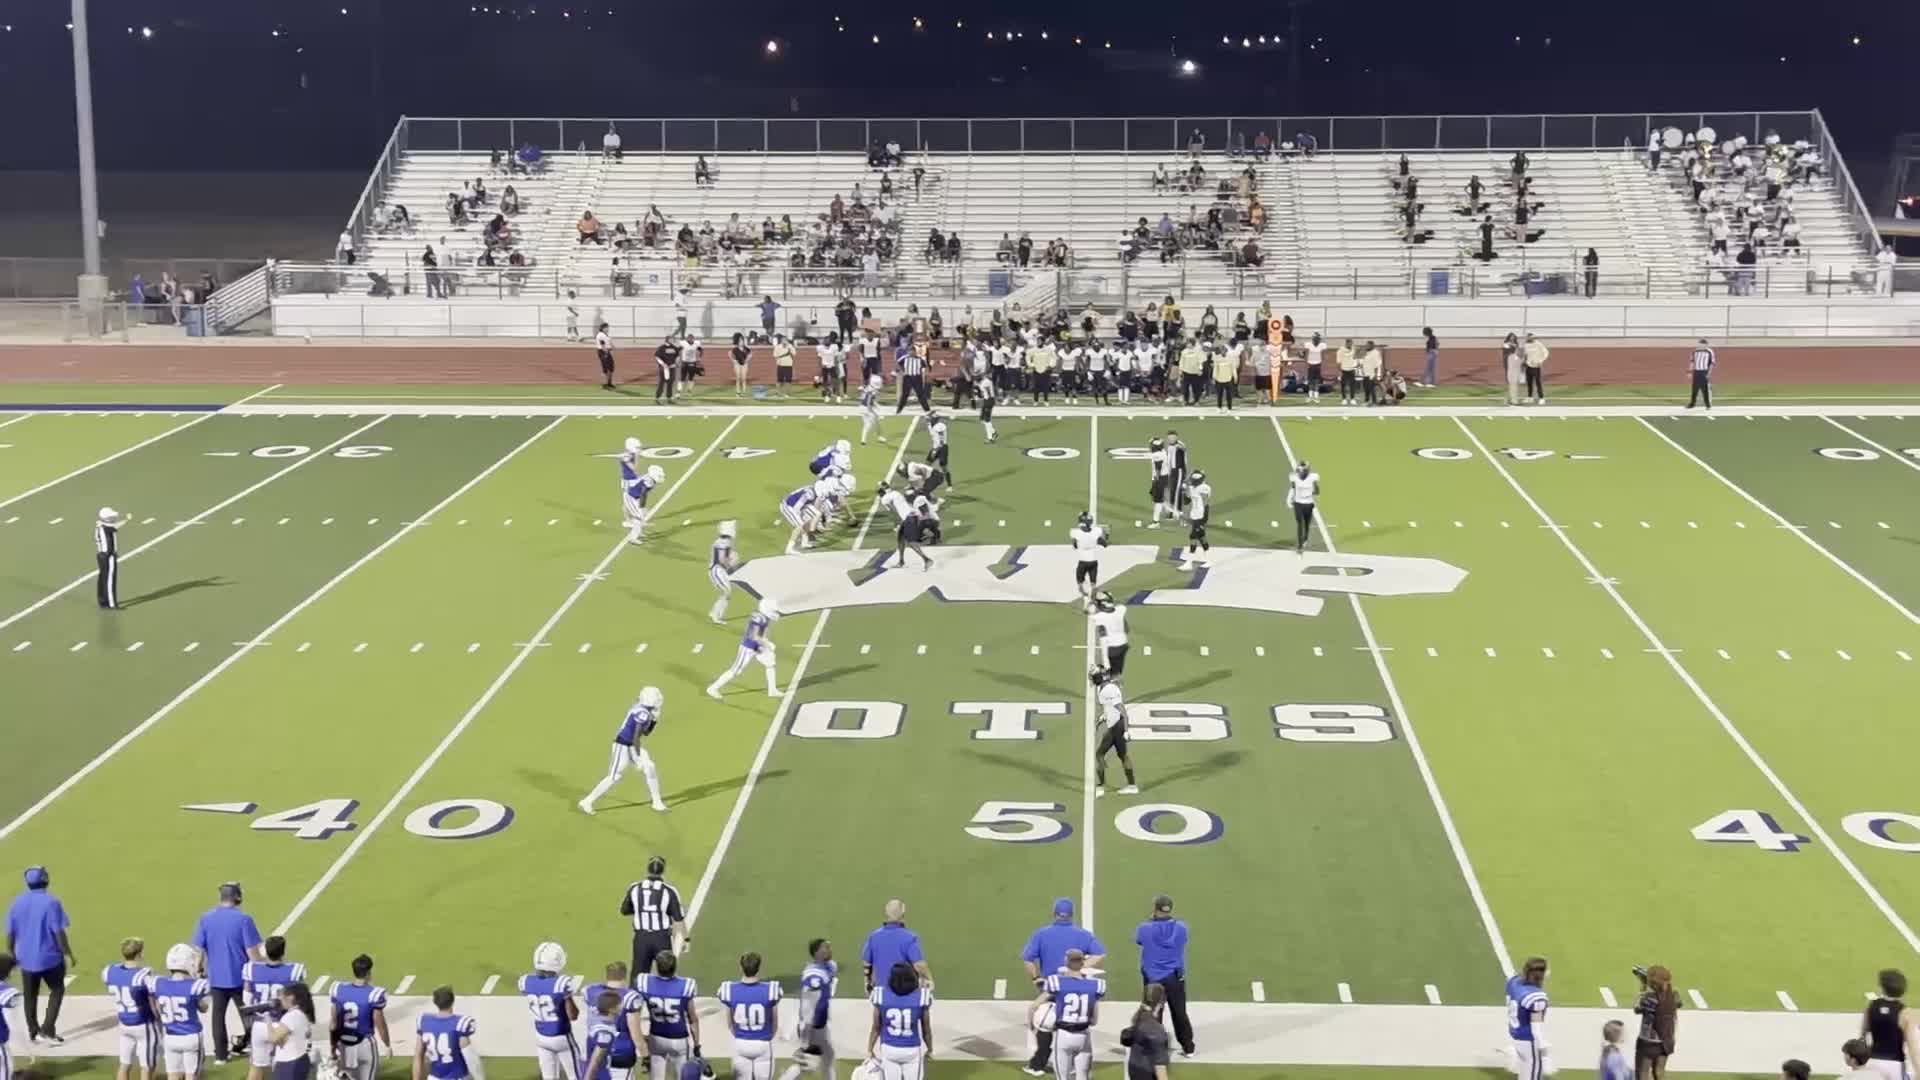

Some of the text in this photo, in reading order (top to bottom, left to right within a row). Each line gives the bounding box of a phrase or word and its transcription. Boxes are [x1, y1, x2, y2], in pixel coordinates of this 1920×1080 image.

[964, 802, 1224, 844] 50
[642, 889, 658, 912] L
[158, 996, 189, 1023] 35
[343, 1001, 359, 1029] 2
[733, 1003, 766, 1031] 40
[886, 1007, 914, 1037] 31
[1062, 993, 1090, 1024] 21
